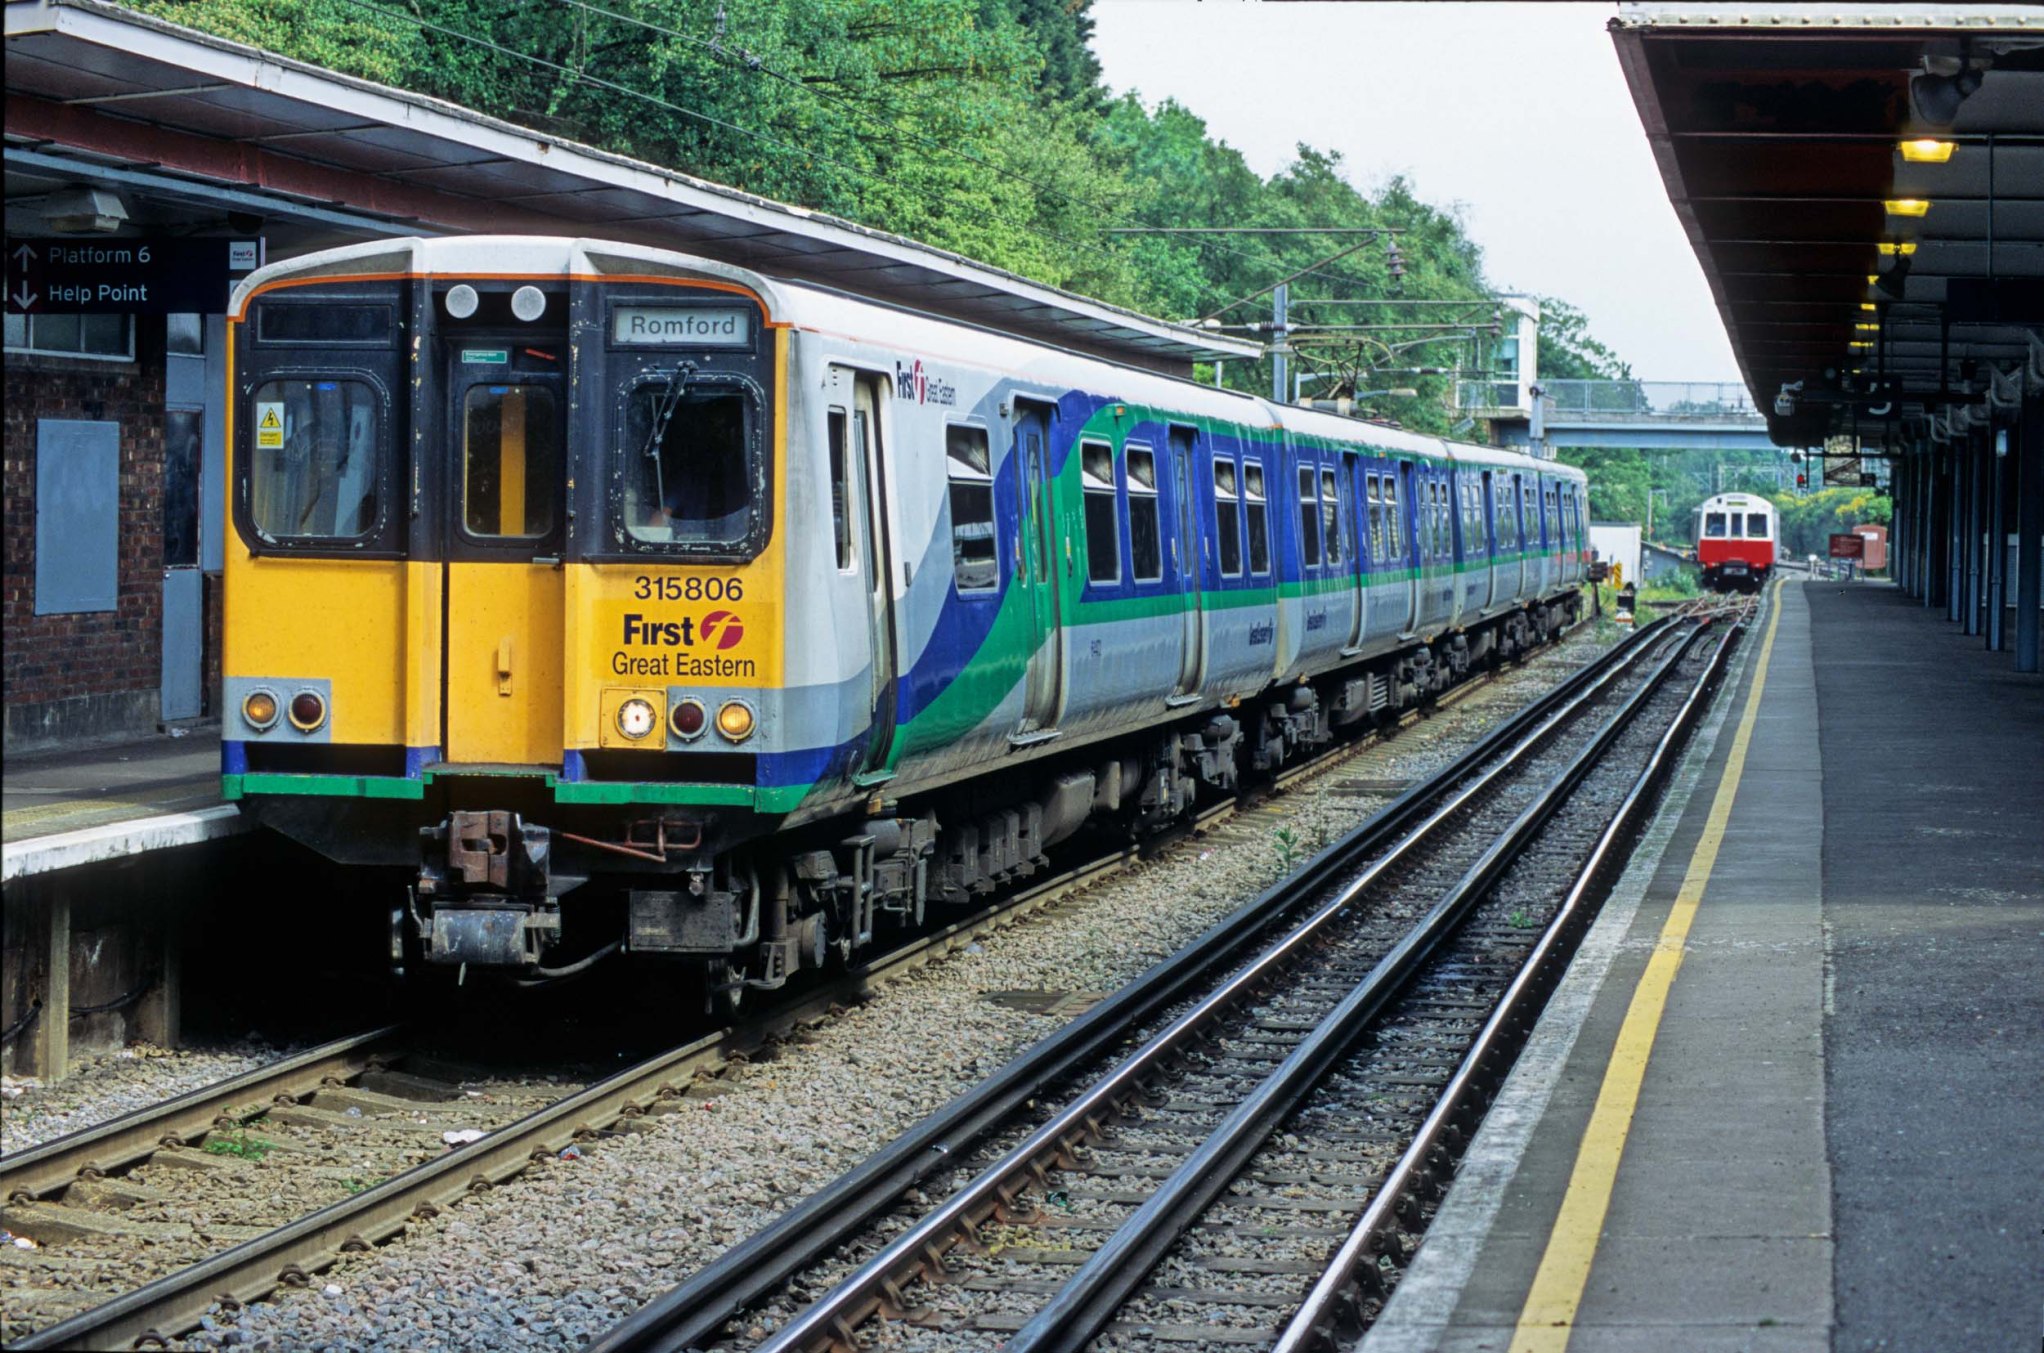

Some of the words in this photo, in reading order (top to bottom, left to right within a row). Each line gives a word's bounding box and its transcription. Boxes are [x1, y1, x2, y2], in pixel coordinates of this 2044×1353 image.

[50, 246, 131, 264] Platform
[138, 246, 150, 263] 6
[50, 285, 91, 304] Help
[99, 284, 148, 301] Point
[631, 315, 735, 335] Romford
[896, 360, 915, 401] First
[634, 576, 743, 601] 315806
[623, 614, 694, 646] First
[612, 651, 669, 676] Great
[676, 653, 755, 677] Eastern
